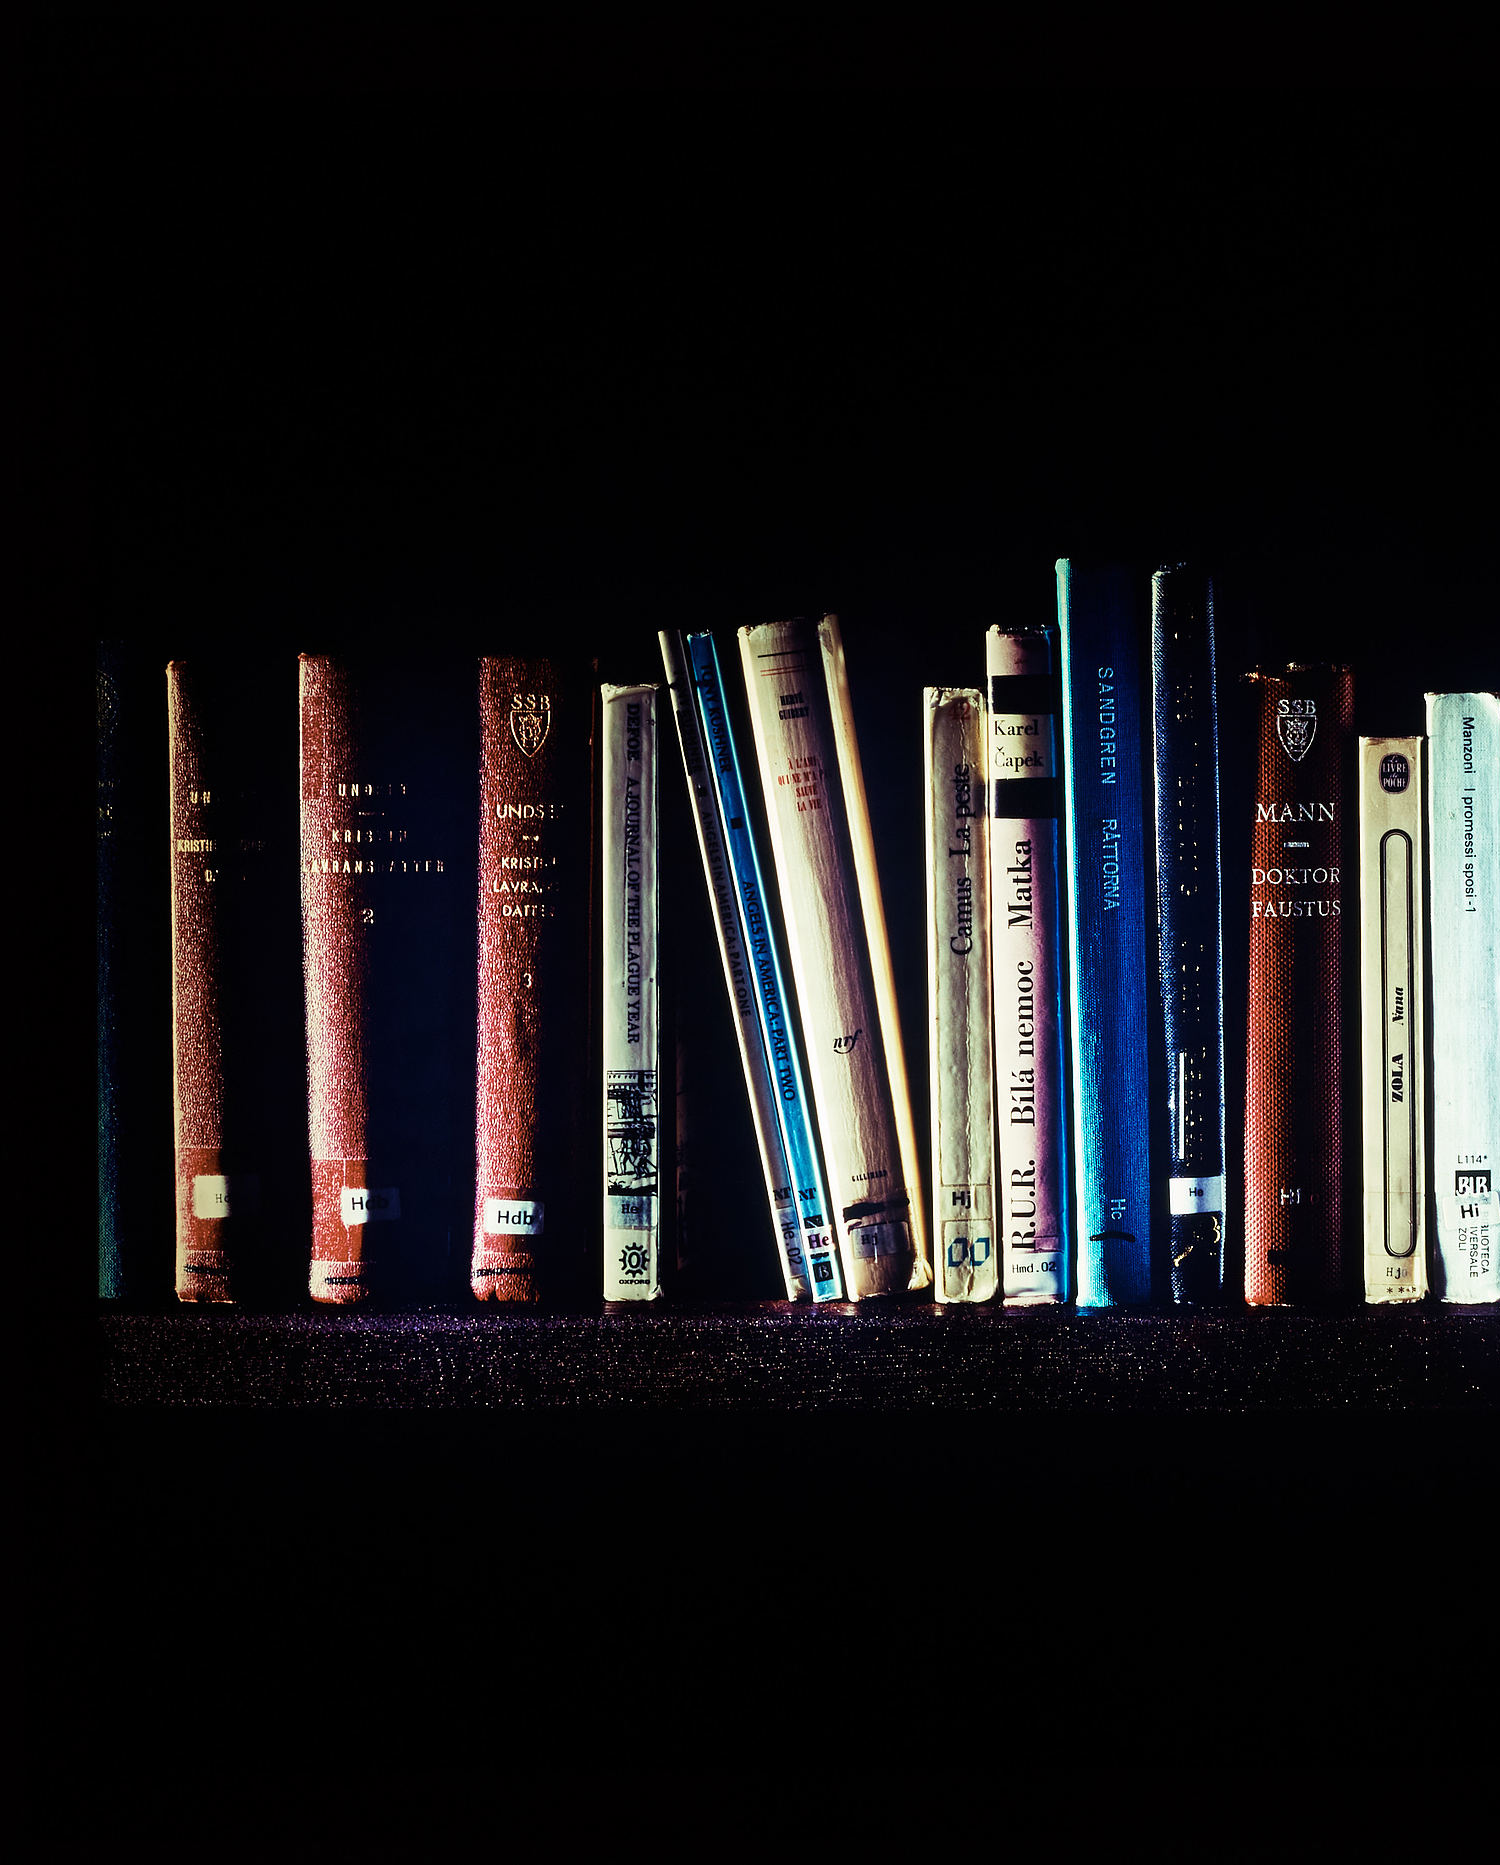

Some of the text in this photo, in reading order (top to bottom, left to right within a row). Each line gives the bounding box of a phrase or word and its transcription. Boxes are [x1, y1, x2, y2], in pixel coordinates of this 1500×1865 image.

[510, 694, 550, 711] SSB
[1277, 699, 1317, 715] SSB
[994, 718, 1040, 736] Karel
[1098, 666, 1117, 785] SANDGREN
[708, 706, 732, 774] KUSHNER
[994, 746, 1045, 772] Čapek
[1382, 763, 1408, 773] LIVRE
[791, 772, 802, 783] NE
[1383, 778, 1407, 788] POCHE
[796, 798, 822, 812] LA VIE
[1255, 803, 1336, 823] MANN
[1461, 716, 1478, 898] Manzoni promessi sposi
[625, 790, 641, 868] JOURNAL
[948, 762, 977, 957] Camus La peste
[627, 872, 641, 892] OF
[1251, 867, 1341, 885] DOKTOR
[362, 908, 375, 924] 2
[627, 893, 641, 928] THE
[742, 880, 762, 936] ANGELS
[1251, 900, 1342, 918] FAUSTUS
[750, 940, 768, 955] IN
[627, 931, 641, 997] PLAGUE
[729, 952, 746, 986] PART
[523, 972, 533, 989] 3
[757, 958, 780, 1026] AMERICA:
[736, 988, 751, 1018] ONE
[627, 1001, 641, 1045] YEAR
[771, 1028, 789, 1062] PART
[832, 1029, 863, 1054] nrf
[1006, 838, 1037, 1251] R.U.R. Bílá nemoc Matka
[1391, 986, 1404, 1103] ZOLA Nana
[777, 1065, 797, 1102] TWO
[620, 1203, 641, 1215] He
[952, 1190, 971, 1209] Hj
[1110, 1198, 1127, 1221] Hc
[496, 1209, 534, 1226] Hdb
[1460, 1203, 1480, 1218] Hi
[807, 1233, 830, 1249] He
[618, 1278, 651, 1286] OXFORD
